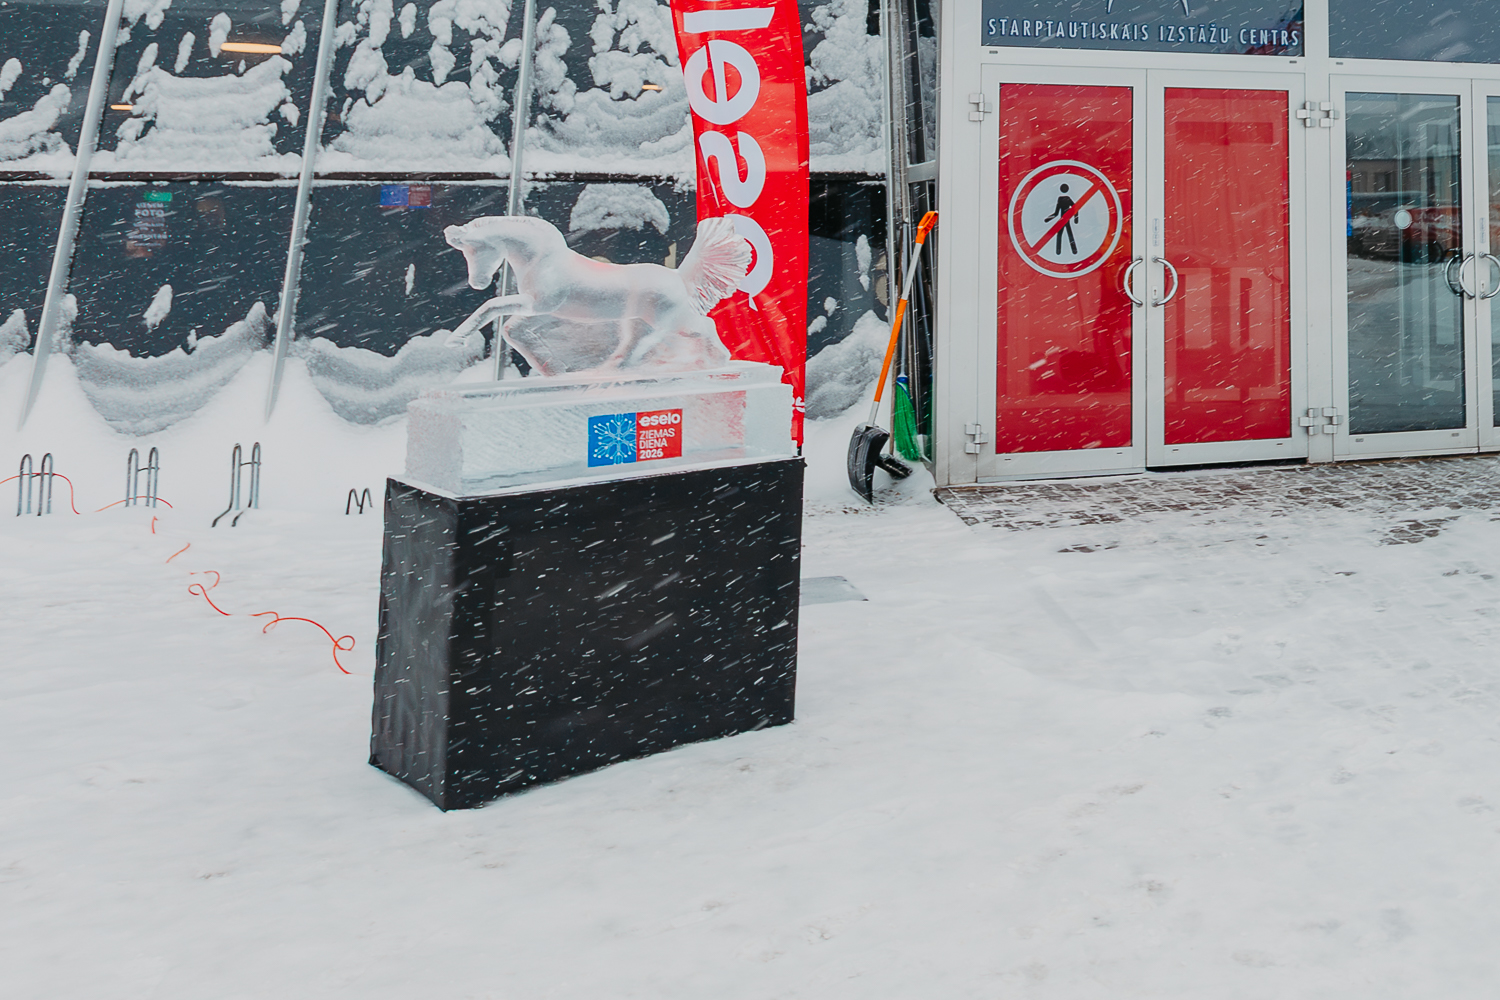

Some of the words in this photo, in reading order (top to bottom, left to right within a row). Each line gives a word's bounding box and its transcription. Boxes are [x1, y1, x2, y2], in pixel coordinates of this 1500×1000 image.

[987, 18, 1149, 41] STARPTAUTISKAIS
[1158, 24, 1229, 45] IZSTĀŽU
[1239, 28, 1300, 46] CENTRS
[639, 413, 681, 427] eselo
[639, 428, 675, 440] ZIEMAS
[639, 438, 668, 450] DIENA
